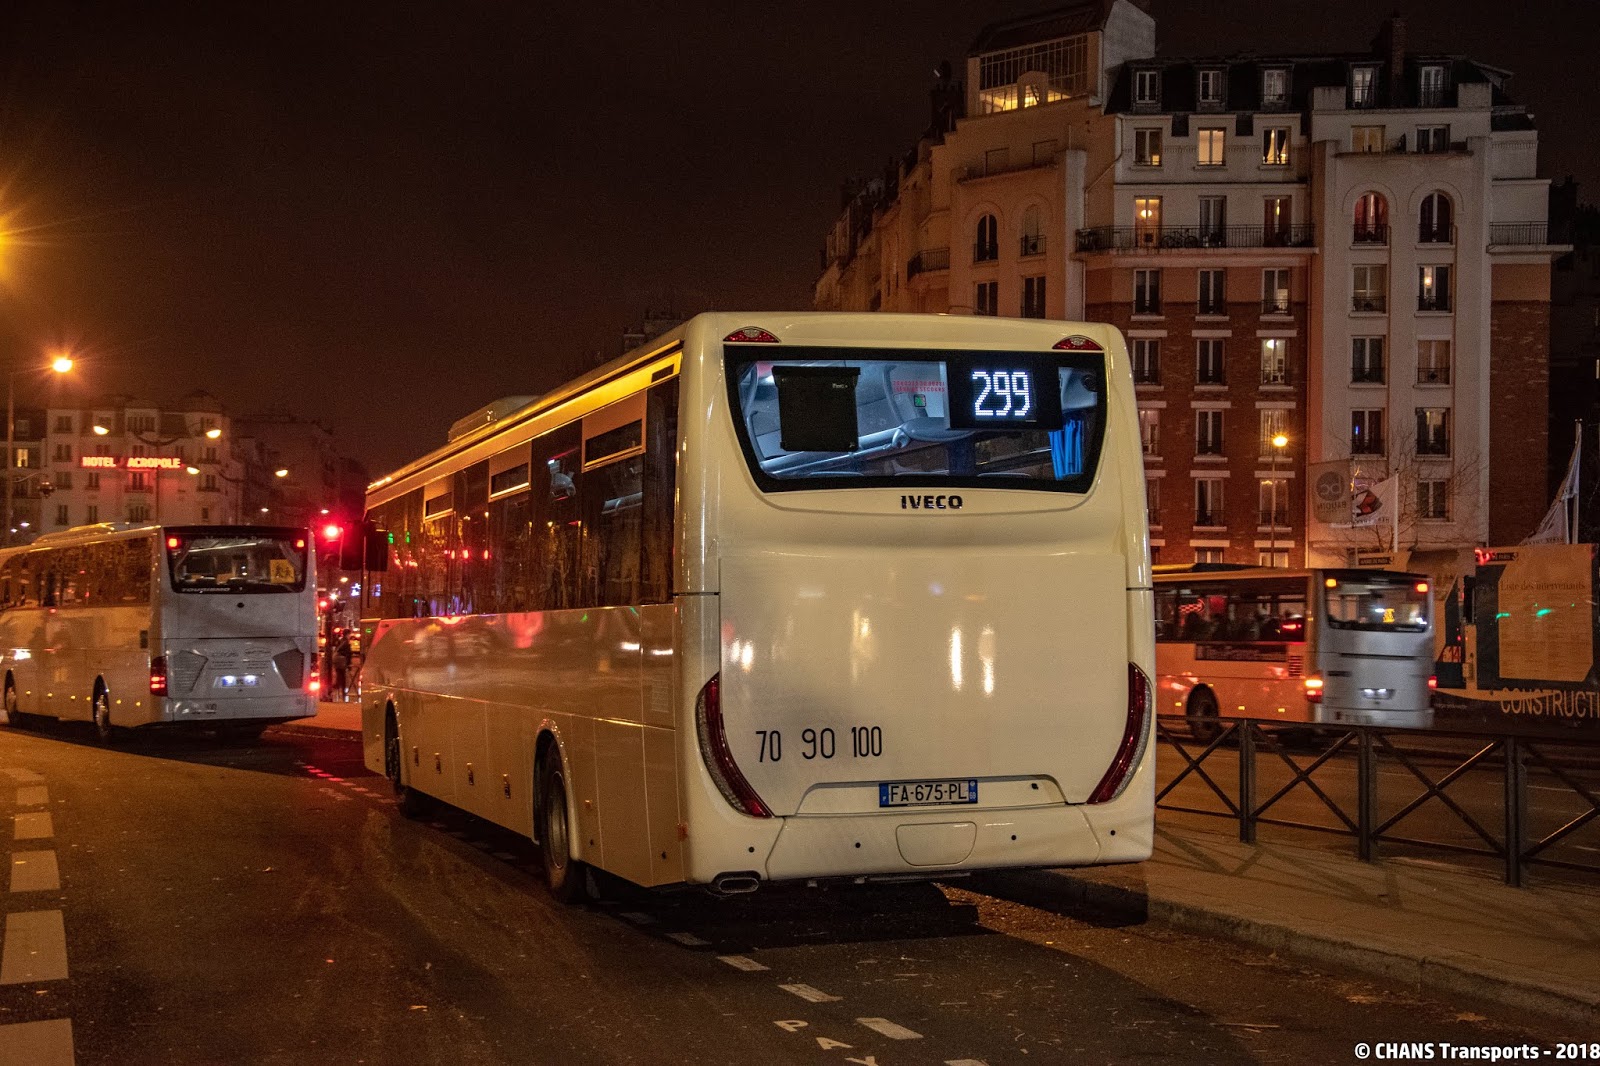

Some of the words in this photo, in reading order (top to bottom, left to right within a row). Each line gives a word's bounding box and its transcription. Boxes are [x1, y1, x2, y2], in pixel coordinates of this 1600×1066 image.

[972, 371, 1030, 416] 299
[82, 457, 117, 468] HOTEL
[126, 457, 182, 469] ACROPOLE
[900, 494, 963, 510] IVECO
[755, 730, 782, 763] 70
[801, 728, 836, 760] 90
[851, 725, 883, 758] 100
[890, 783, 968, 802] FA-675-PL
